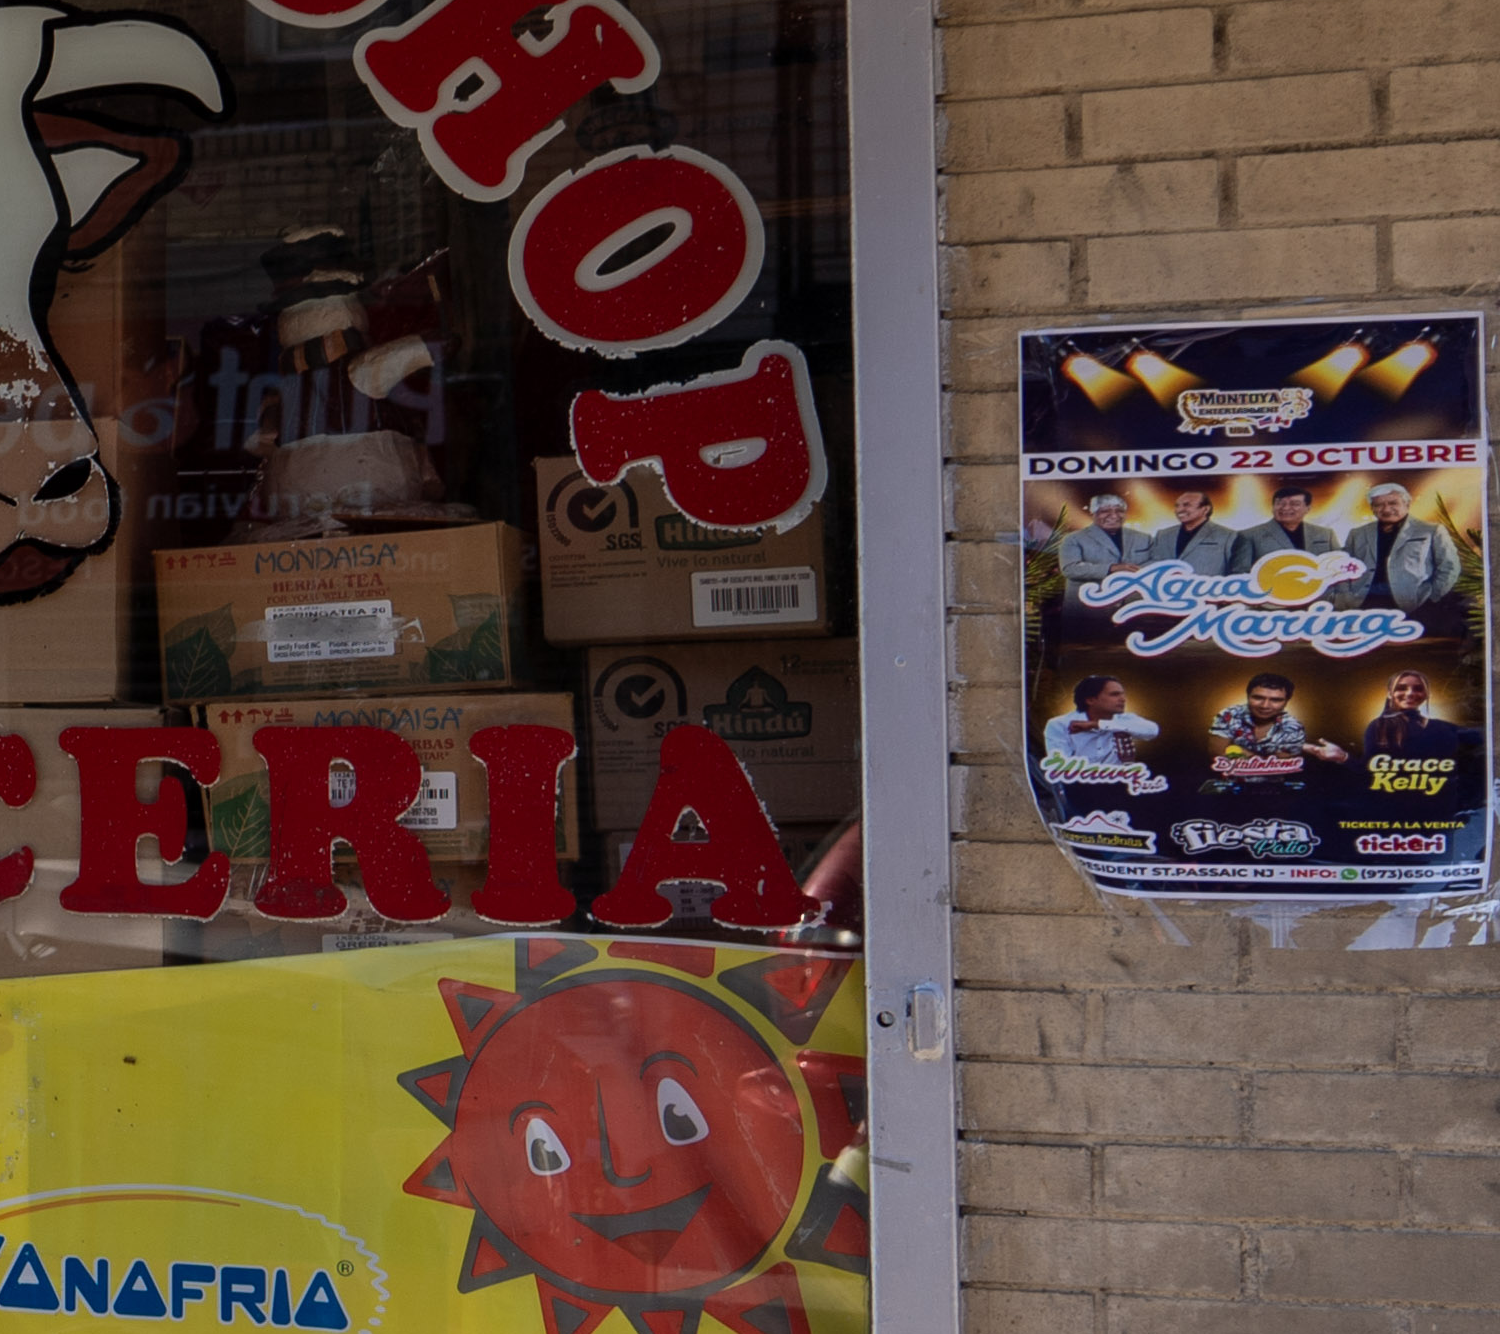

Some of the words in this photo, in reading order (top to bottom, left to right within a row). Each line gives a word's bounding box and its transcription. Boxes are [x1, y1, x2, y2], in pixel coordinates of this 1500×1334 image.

[1198, 390, 1281, 407] MONTOYA
[1028, 452, 1219, 475] DOMINGO
[1229, 450, 1274, 469] 22
[1285, 443, 1478, 467] OCTUBRE
[606, 534, 643, 551] SGS
[255, 542, 396, 574] MONDAISA
[711, 550, 768, 566] natural
[272, 574, 336, 593] HERBAL
[344, 572, 385, 589] TEA
[1080, 560, 1262, 613] Agua
[1114, 603, 1424, 658] Marina
[757, 744, 815, 758] natural
[1368, 752, 1457, 774] Grace
[1368, 770, 1449, 796] Kelly
[1338, 820, 1389, 831] TICKETS
[1391, 820, 1403, 831] A
[1404, 820, 1422, 831] LA
[1423, 819, 1466, 831] VENTA
[1252, 867, 1275, 879] NJ
[1289, 866, 1338, 880] INFO:
